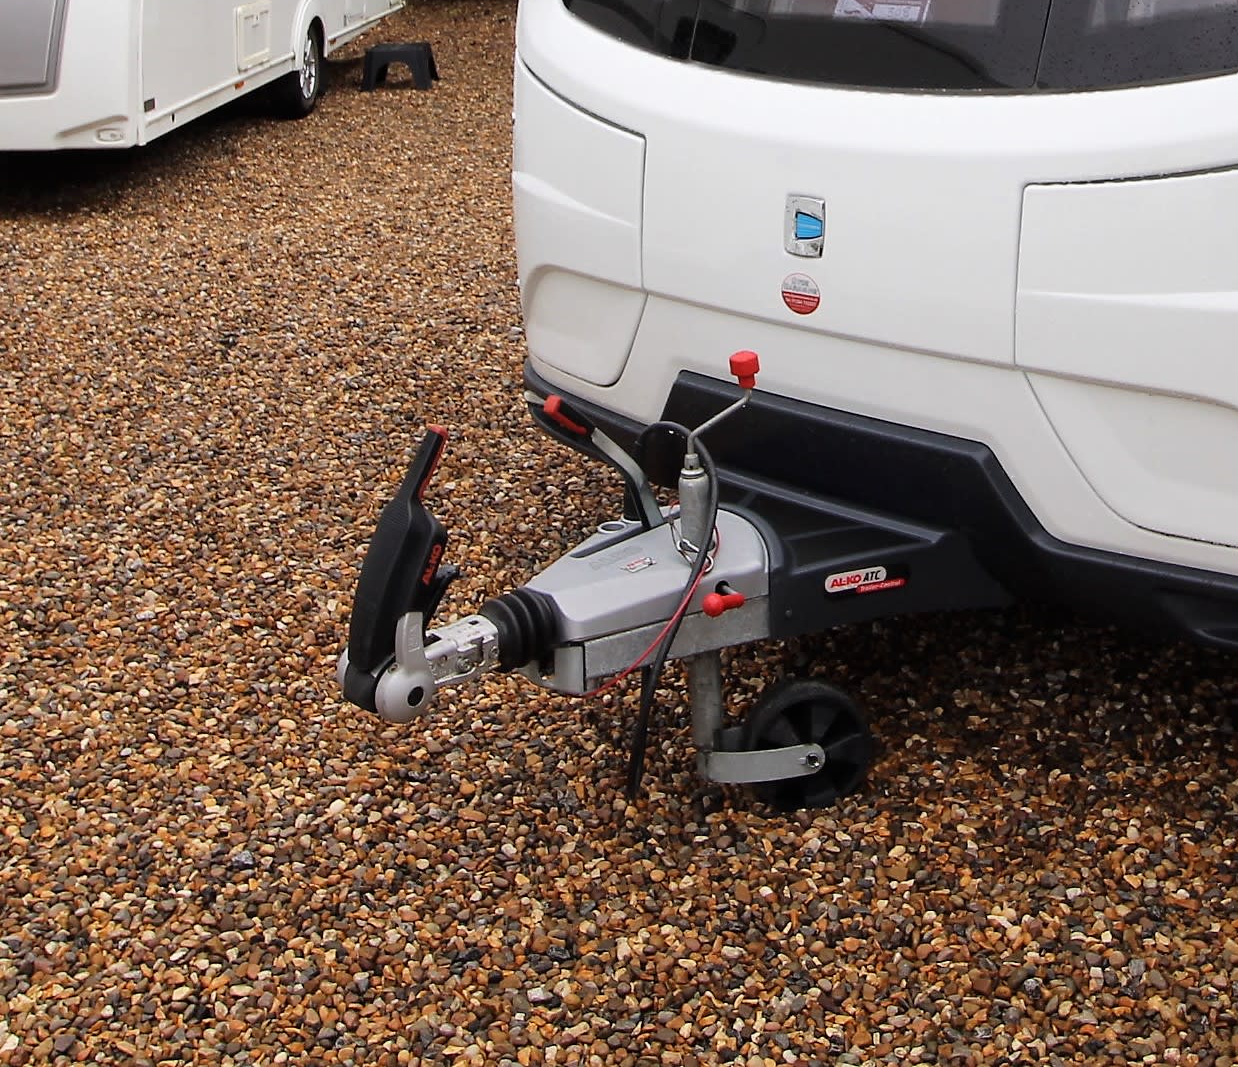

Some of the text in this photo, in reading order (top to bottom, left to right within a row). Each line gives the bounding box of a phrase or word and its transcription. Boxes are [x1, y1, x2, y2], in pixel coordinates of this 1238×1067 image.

[422, 543, 442, 585] AL-KO
[830, 570, 882, 588] AL-KO ATC
